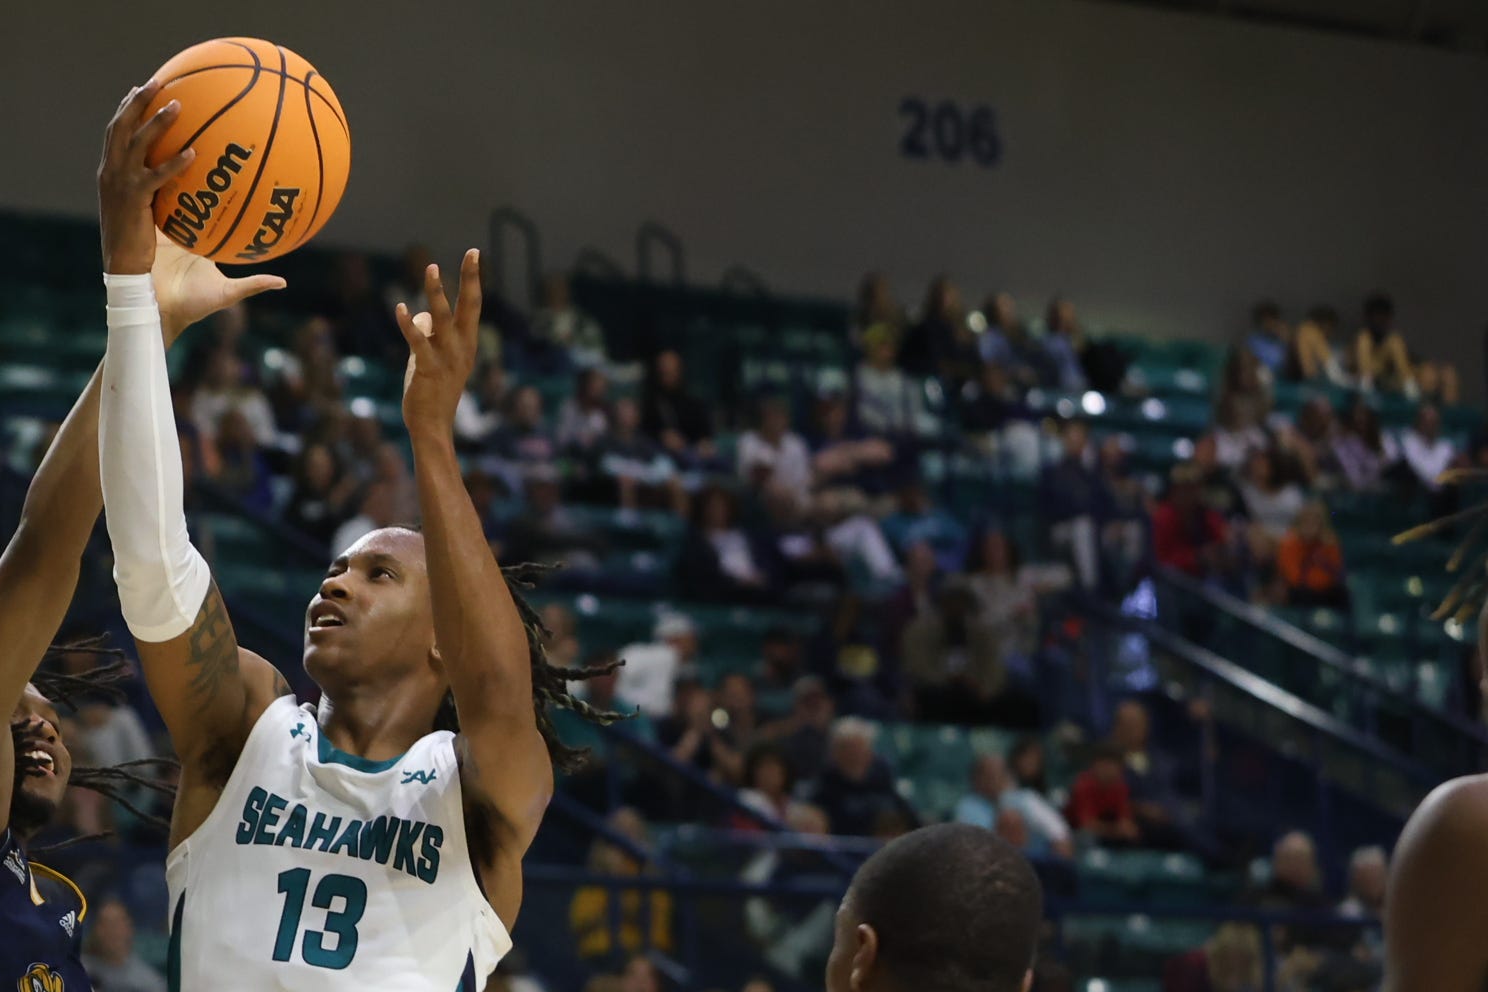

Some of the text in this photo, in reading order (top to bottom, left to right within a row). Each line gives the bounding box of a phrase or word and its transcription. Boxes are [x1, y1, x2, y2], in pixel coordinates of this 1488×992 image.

[898, 96, 1004, 168] 206
[162, 141, 253, 249] Wilson
[234, 187, 301, 261] NCAA
[235, 785, 444, 885] SEAHAWKS
[272, 866, 368, 971] 13
